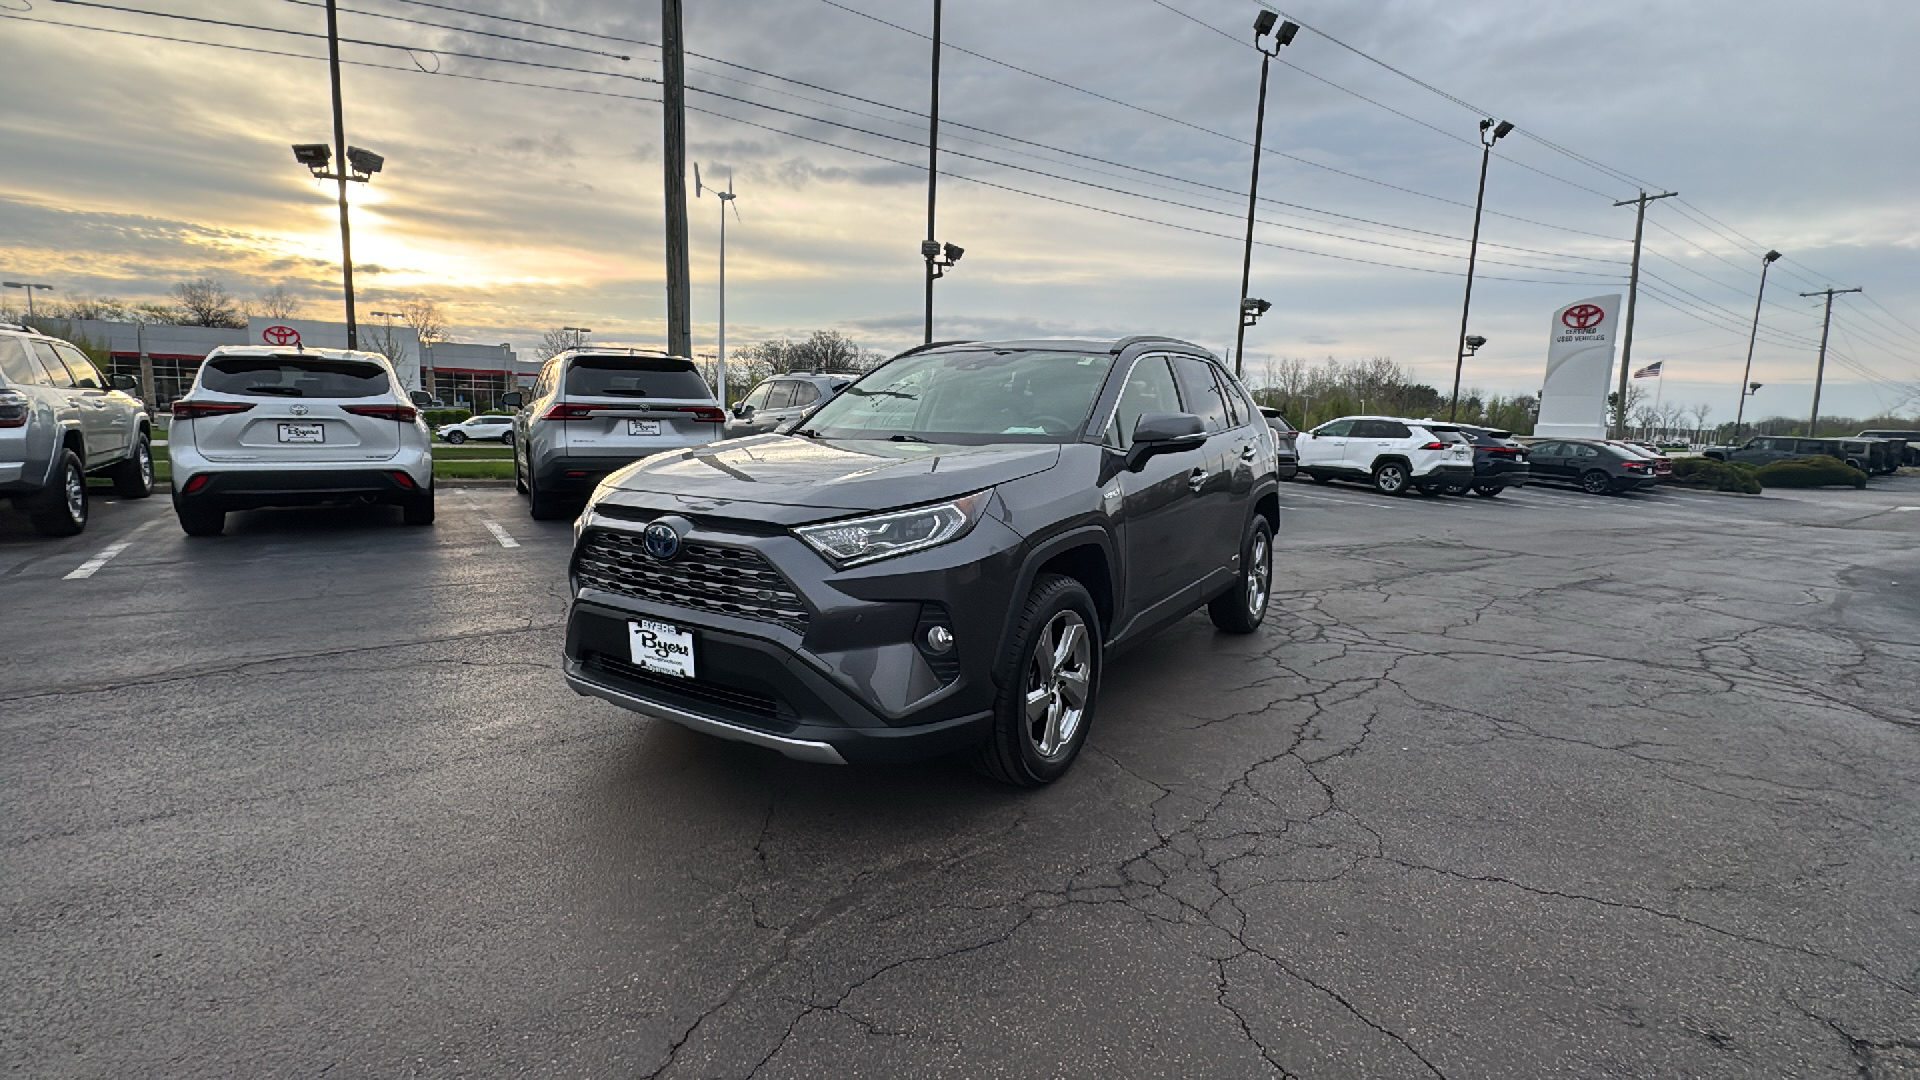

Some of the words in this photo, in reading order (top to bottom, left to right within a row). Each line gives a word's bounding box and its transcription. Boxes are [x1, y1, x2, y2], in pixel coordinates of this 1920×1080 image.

[1556, 335, 1573, 343] USED
[1574, 334, 1605, 342] VEHICLES
[641, 620, 677, 634] BYERS
[634, 629, 689, 658] Byers
